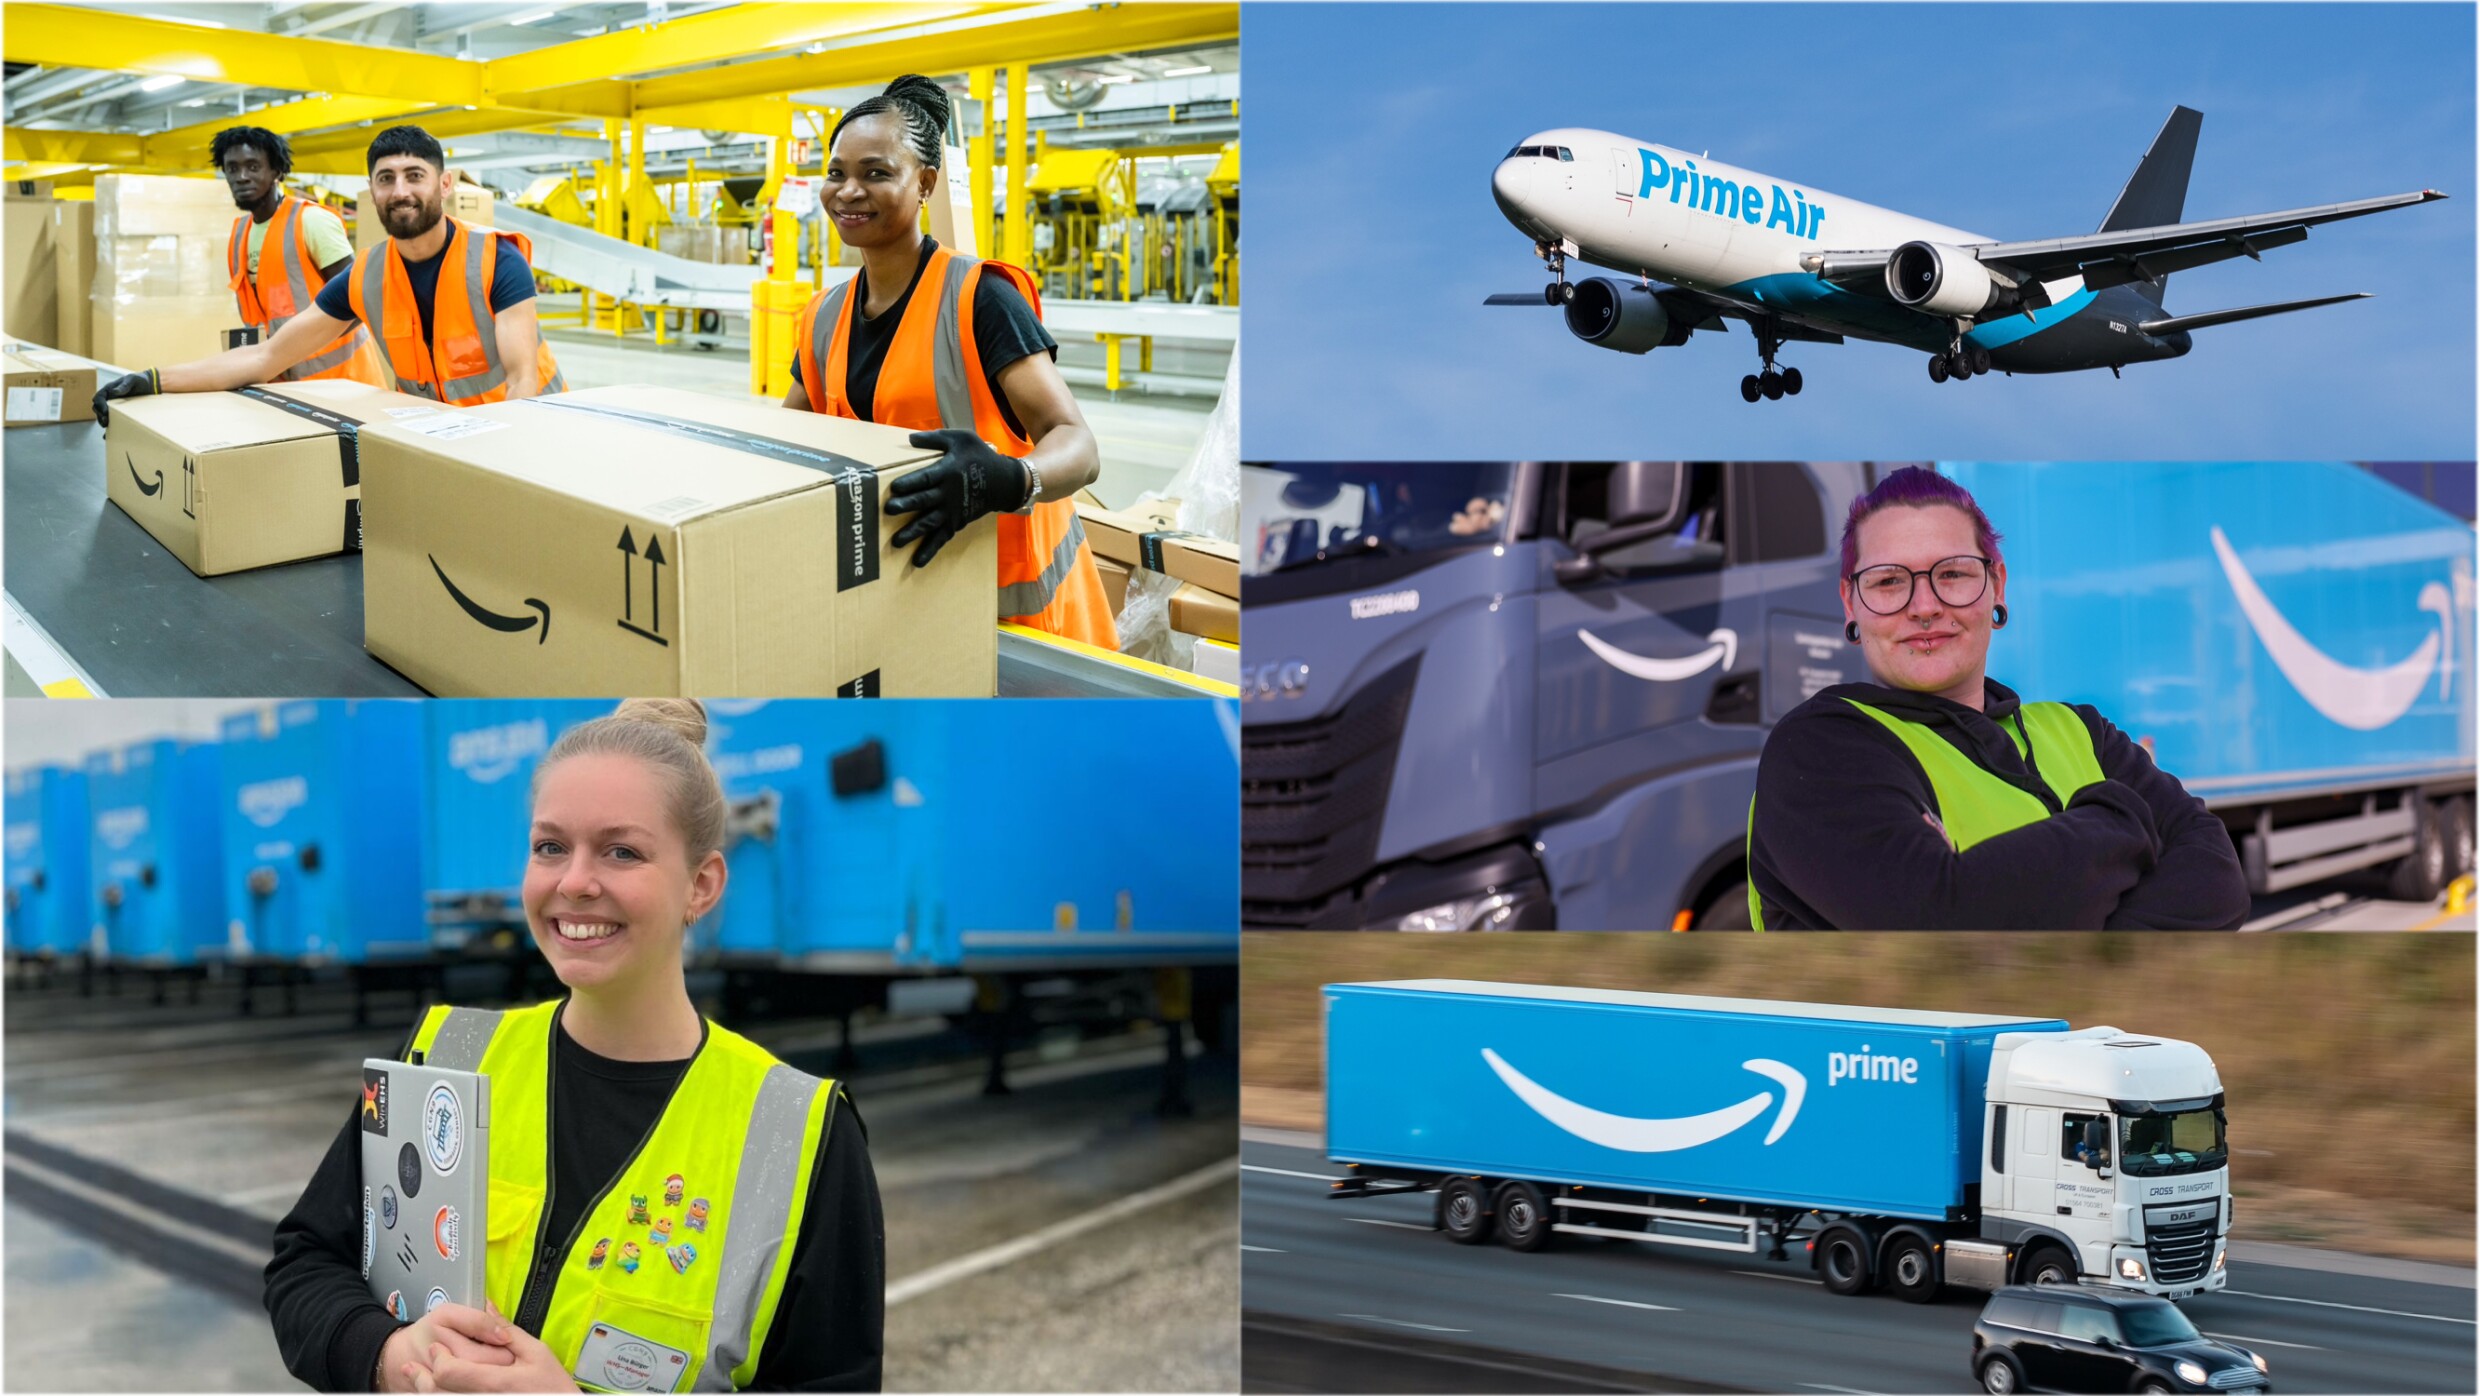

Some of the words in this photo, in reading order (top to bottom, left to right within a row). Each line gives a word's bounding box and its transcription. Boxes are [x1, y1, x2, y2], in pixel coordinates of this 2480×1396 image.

[1638, 148, 1764, 225] Prime
[1766, 184, 1825, 240] Air
[845, 466, 863, 522] amazon
[851, 523, 866, 576] prime
[1828, 1044, 1919, 1087] prime
[379, 1076, 387, 1129] WinEHS
[2056, 1183, 2077, 1192] CROSS
[2079, 1186, 2113, 1195] TRANSPORT
[2150, 1187, 2174, 1197] CROSS
[2178, 1182, 2214, 1193] TRANSPORT
[362, 1188, 371, 1280] transportation
[2170, 1211, 2196, 1222] DAF
[646, 1386, 667, 1394] amazon
